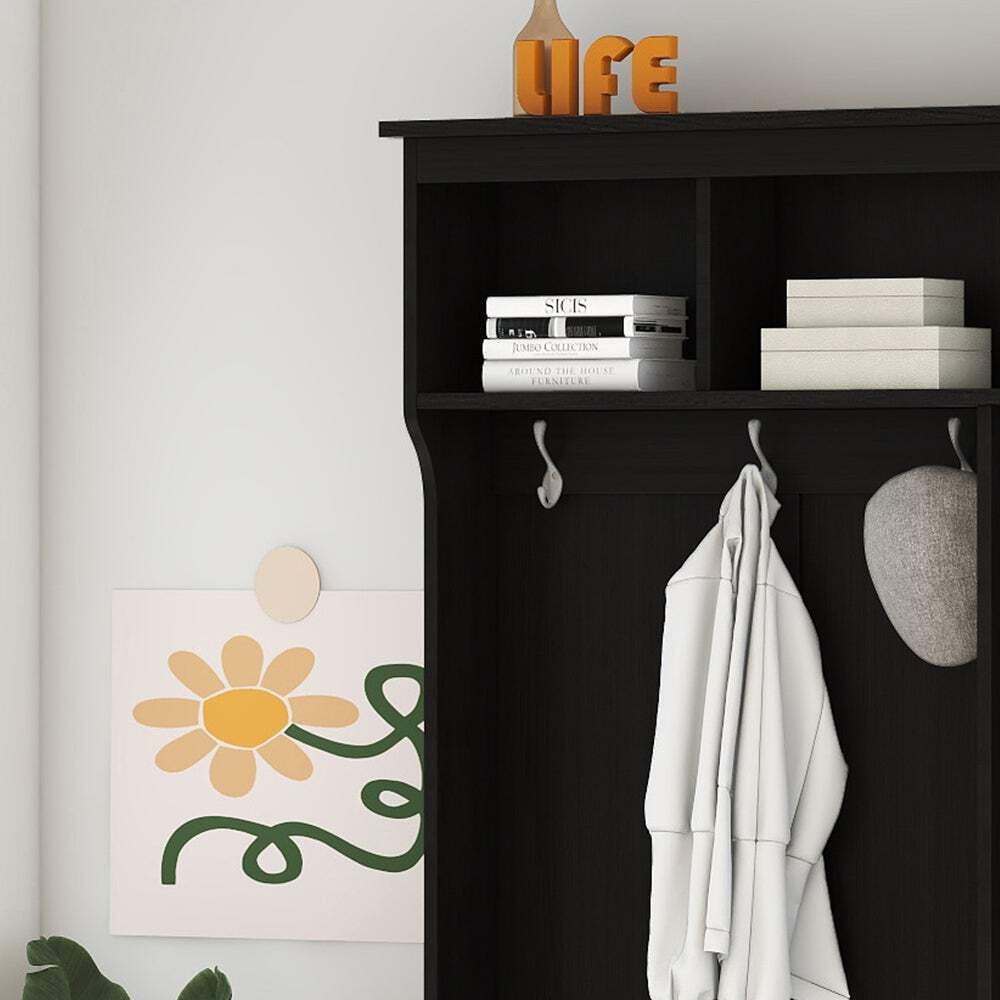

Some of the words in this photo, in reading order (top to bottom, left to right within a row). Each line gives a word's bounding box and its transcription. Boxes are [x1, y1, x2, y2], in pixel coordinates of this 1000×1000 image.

[516, 35, 678, 116] LIFE
[544, 298, 588, 314] SICIS
[556, 367, 576, 375] THE
[580, 366, 615, 375] HOUSE
